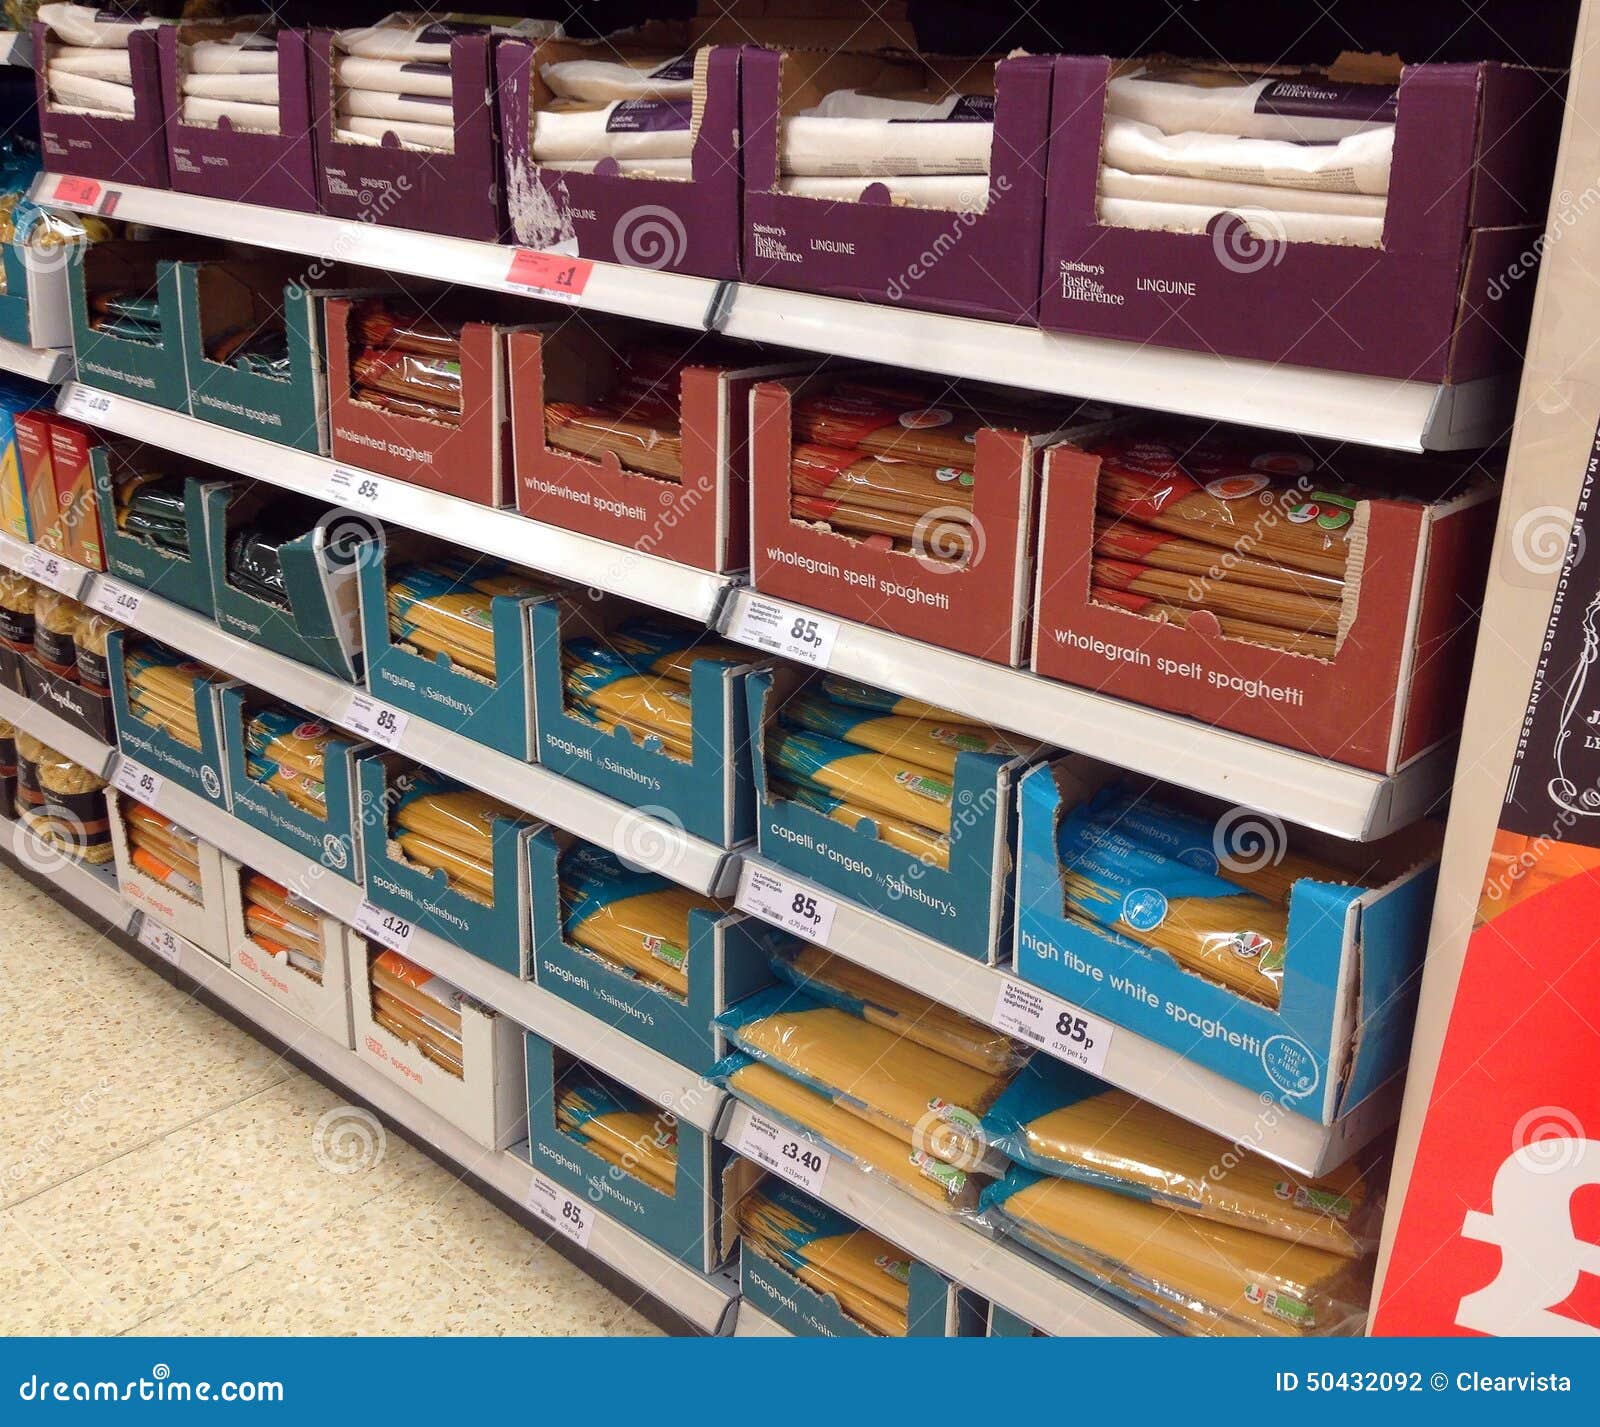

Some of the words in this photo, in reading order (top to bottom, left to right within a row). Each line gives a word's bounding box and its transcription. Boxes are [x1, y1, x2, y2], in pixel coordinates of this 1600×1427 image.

[753, 222, 786, 237] Sainsbury's
[753, 233, 777, 248] Taste
[755, 245, 803, 263] Difference
[810, 238, 856, 255] LINGUINE
[556, 266, 577, 287] £1
[1060, 259, 1105, 275] Sainsbury's
[1060, 271, 1092, 289] Taste
[1062, 284, 1125, 306] Difference
[1136, 277, 1197, 296] LINGUINE
[335, 426, 387, 452] wholewheat
[387, 443, 433, 464] spaghetti
[524, 474, 591, 505] wholewheat
[593, 495, 647, 522] spaghetti
[1578, 457, 1599, 512] MADE
[1572, 518, 1584, 536] IN
[766, 546, 840, 580] wholegrain
[843, 568, 876, 591] spelt
[880, 578, 950, 611] spaghetti
[1543, 542, 1578, 652] LYNCHBURG
[790, 617, 823, 648] 85p
[1054, 626, 1151, 667] wholegrain
[1156, 655, 1202, 681] spelt
[1207, 667, 1305, 707] spaghetti
[381, 667, 416, 692] linguine
[426, 686, 474, 716] Sainsbury's
[376, 709, 398, 735] 85p
[1516, 657, 1549, 760] TENNESSEE
[546, 730, 593, 764] spaghetti
[604, 755, 661, 791] Sainsbury's
[770, 821, 815, 850] capelli
[815, 838, 873, 878] d'angelo
[886, 873, 957, 918] Sainsbury's
[372, 874, 414, 902] spaghetti
[423, 898, 469, 931] Sainsbury's
[791, 892, 821, 925] 85p
[382, 916, 410, 938] £1.20
[544, 958, 590, 992] spaghetti
[600, 987, 655, 1027] Sainsbury's
[1003, 997, 1027, 1011] spaghetti
[1005, 990, 1017, 999] high
[1016, 994, 1029, 1005] fibre
[1029, 1000, 1044, 1011] white
[1006, 983, 1013, 991] by
[1013, 985, 1042, 1004] Sainsbury's
[1021, 929, 1059, 965] high
[1063, 949, 1105, 983] fibre
[1109, 971, 1160, 1010] white
[1165, 1000, 1261, 1059] spaghetti
[1055, 1011, 1094, 1050] 85p
[1067, 1047, 1079, 1057] per
[1079, 1052, 1088, 1064] kg
[1279, 1041, 1308, 1064] TRIPLE
[1283, 1053, 1298, 1067] THE
[1277, 1058, 1301, 1078] FIBRE
[781, 1142, 822, 1173] £3.40
[538, 1141, 582, 1177] spaghetti
[591, 1174, 645, 1215] Sainsbury's
[562, 1200, 584, 1229] 85p
[749, 1269, 798, 1314] spaghetti
